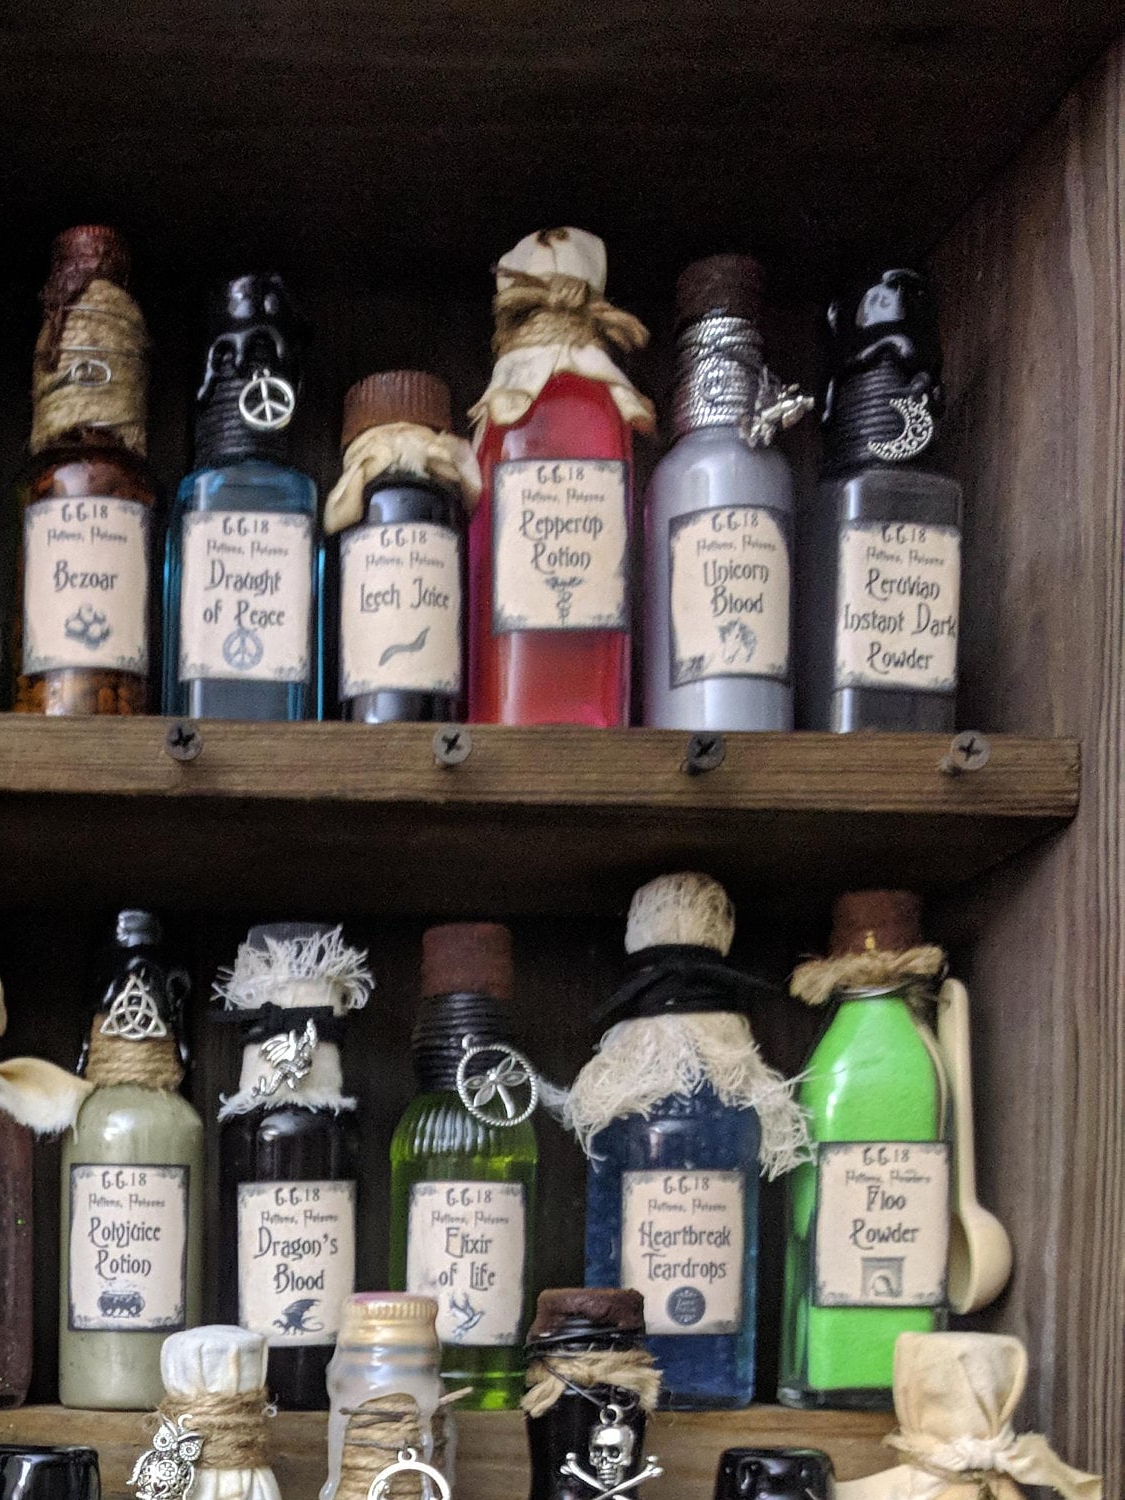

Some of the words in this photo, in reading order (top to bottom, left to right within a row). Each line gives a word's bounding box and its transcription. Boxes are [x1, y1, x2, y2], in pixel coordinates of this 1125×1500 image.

[519, 510, 603, 541] Pepperup
[531, 542, 590, 575] Potion
[704, 561, 769, 587] Unicorn
[54, 560, 118, 591] Bezoar
[205, 560, 282, 596] Draught
[865, 568, 940, 601] Peruvian
[361, 584, 401, 612] Leech
[410, 578, 450, 609] Juice
[711, 586, 763, 616] Blood
[203, 601, 222, 624] of
[235, 601, 285, 629] Peace
[844, 604, 904, 633] Instant
[867, 641, 934, 674] Powder
[867, 1185, 906, 1214] Floo
[88, 1217, 160, 1248] Polyjuice
[254, 1227, 338, 1260] Dragon's
[445, 1227, 492, 1258] Elixir
[638, 1221, 730, 1250] Heartbreak
[849, 1218, 919, 1250] Powder
[95, 1250, 152, 1280] Potion
[273, 1263, 325, 1293] Blood
[439, 1263, 457, 1287] of
[642, 1252, 727, 1282] Teardrops
